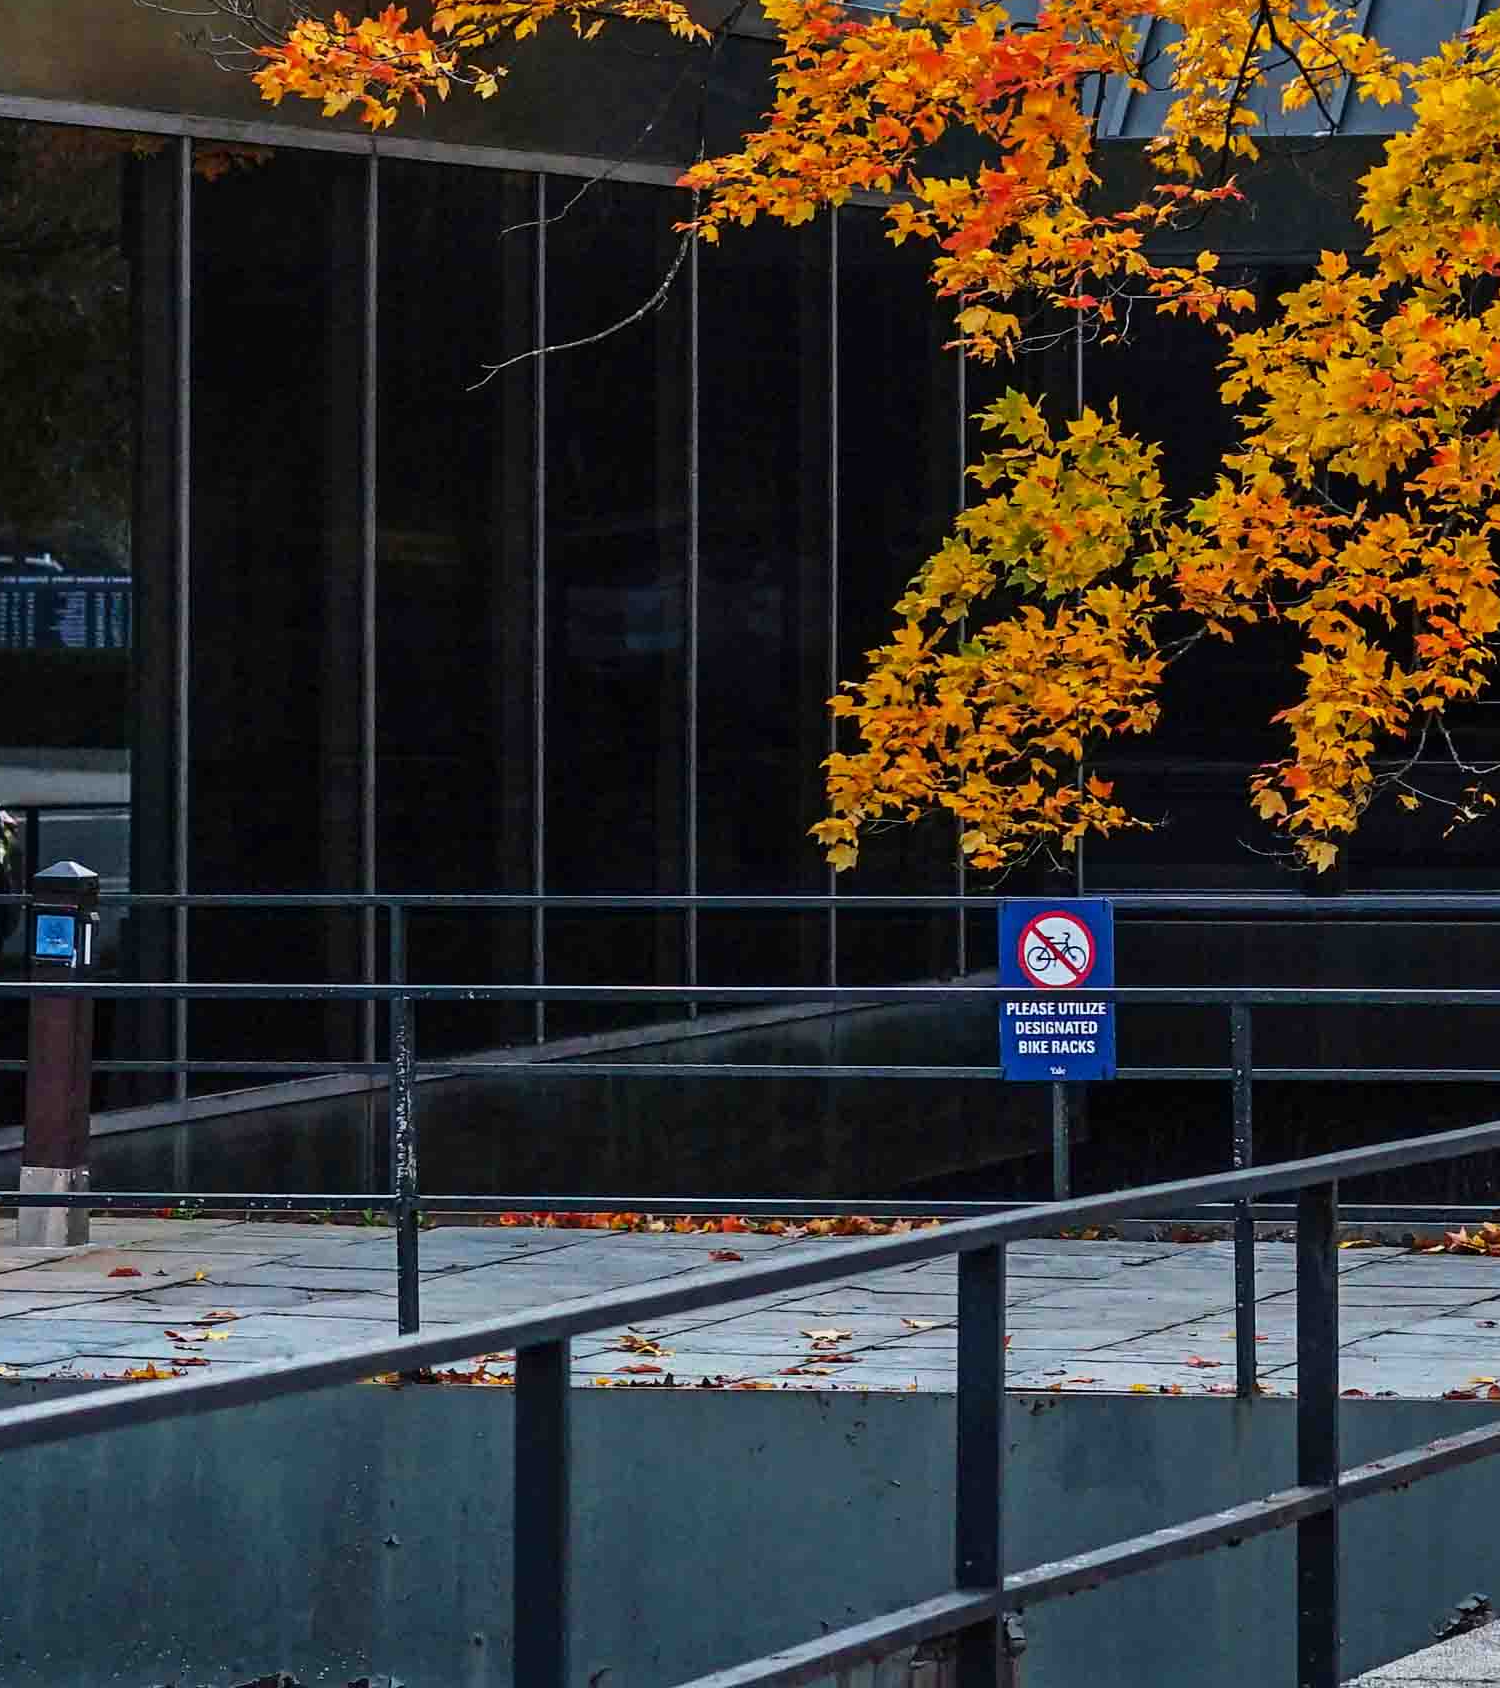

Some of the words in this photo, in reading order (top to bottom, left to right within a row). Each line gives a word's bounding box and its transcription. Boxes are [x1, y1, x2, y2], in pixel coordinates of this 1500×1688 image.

[1006, 1002, 1056, 1016] PLEASE
[1058, 1002, 1107, 1015] UTILIZE
[1015, 1021, 1098, 1035] DESIGNATED
[1018, 1040, 1049, 1054] BIKE
[1051, 1040, 1095, 1054] RACKS
[1049, 1066, 1066, 1075] Yale
